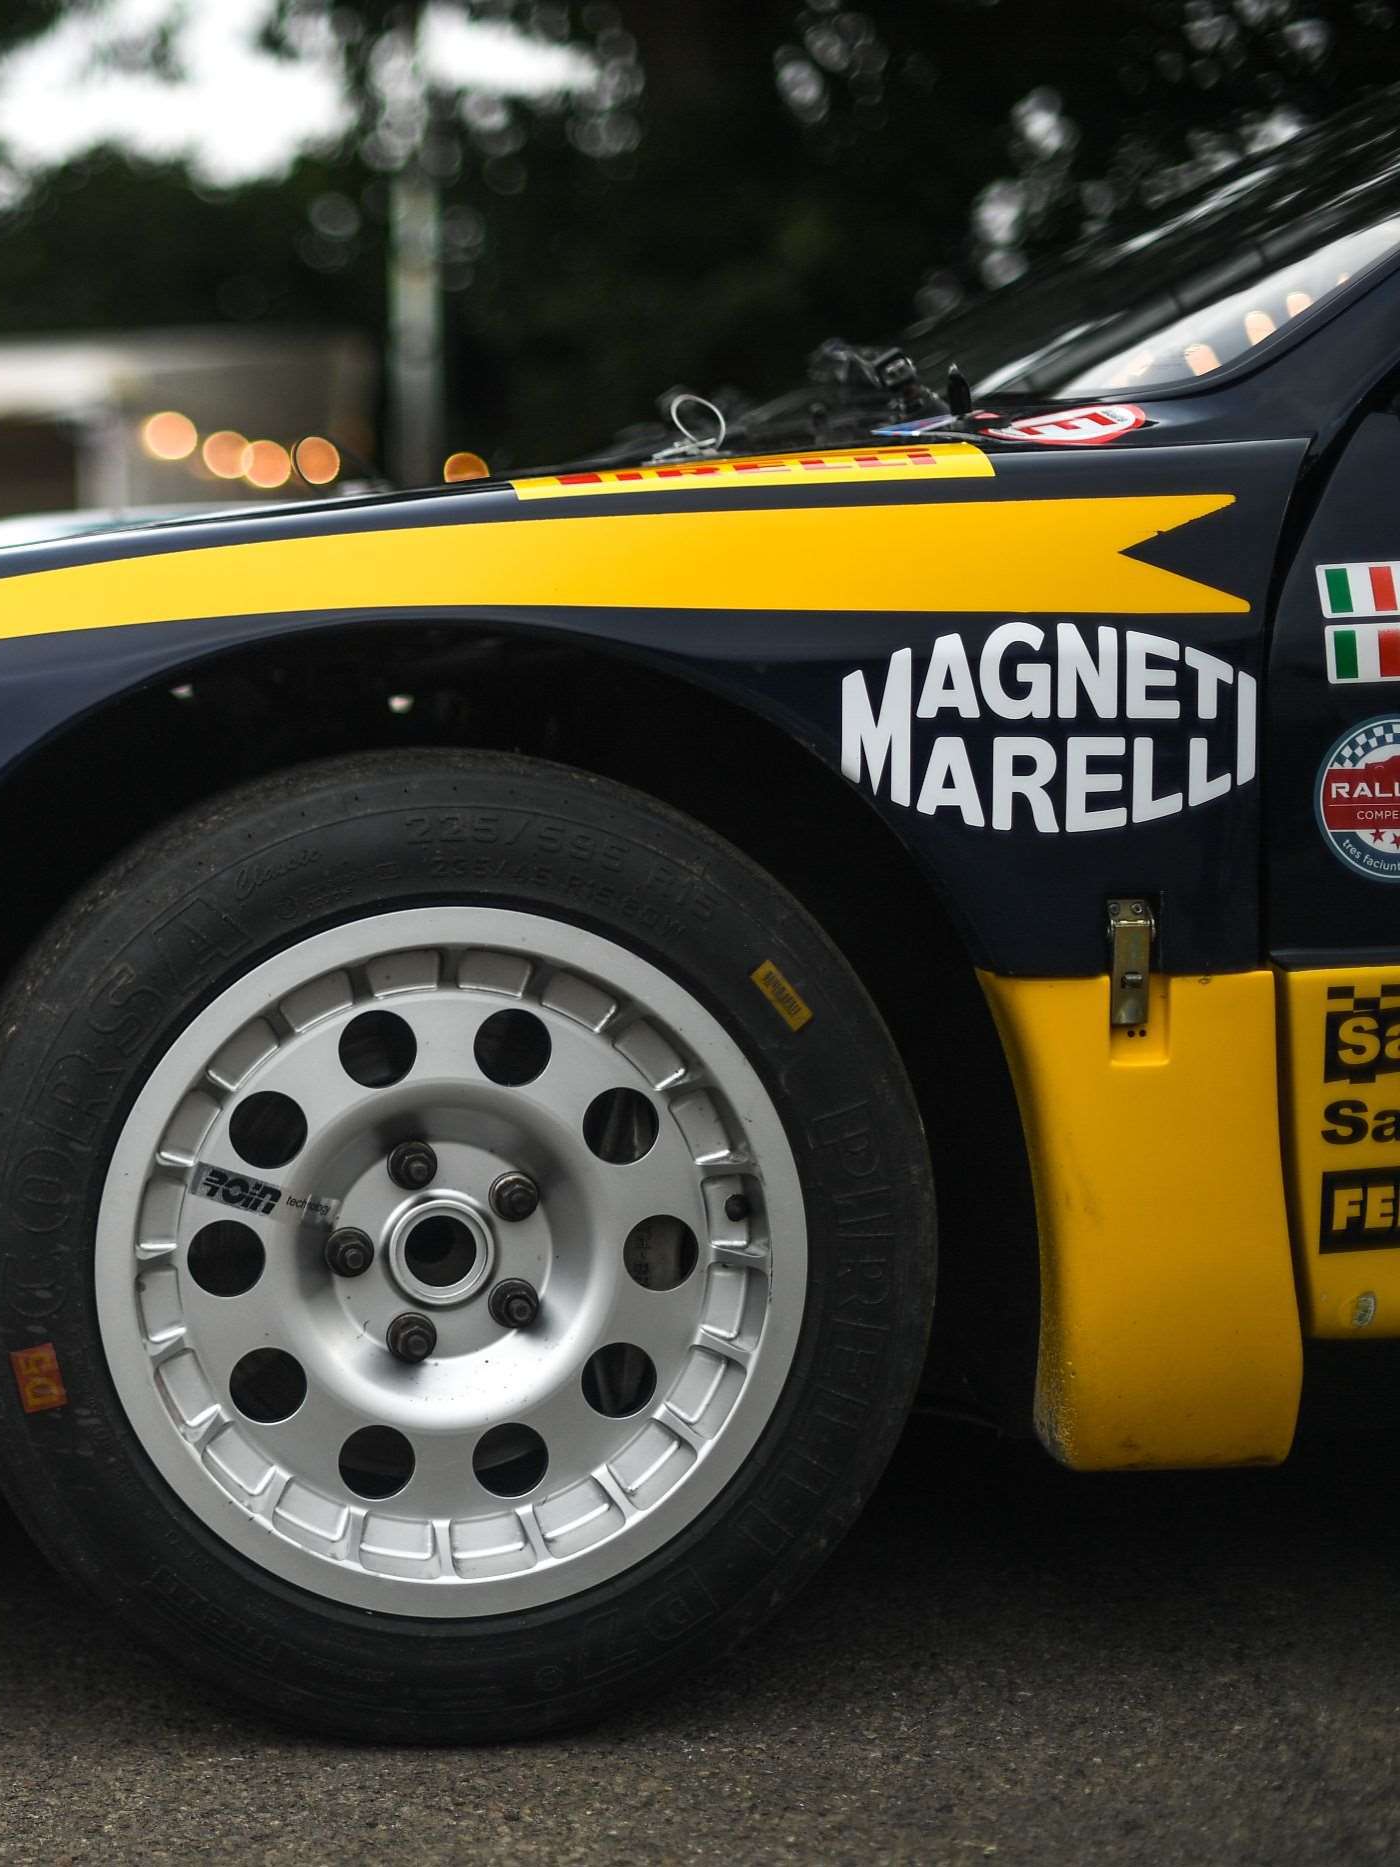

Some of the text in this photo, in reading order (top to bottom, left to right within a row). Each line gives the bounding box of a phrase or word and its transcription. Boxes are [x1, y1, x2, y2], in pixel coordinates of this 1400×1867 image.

[841, 622, 1257, 807] MAGNETI
[841, 648, 1257, 833] MARELLI
[1342, 839, 1362, 859] tres
[1332, 1185, 1400, 1231] FE
